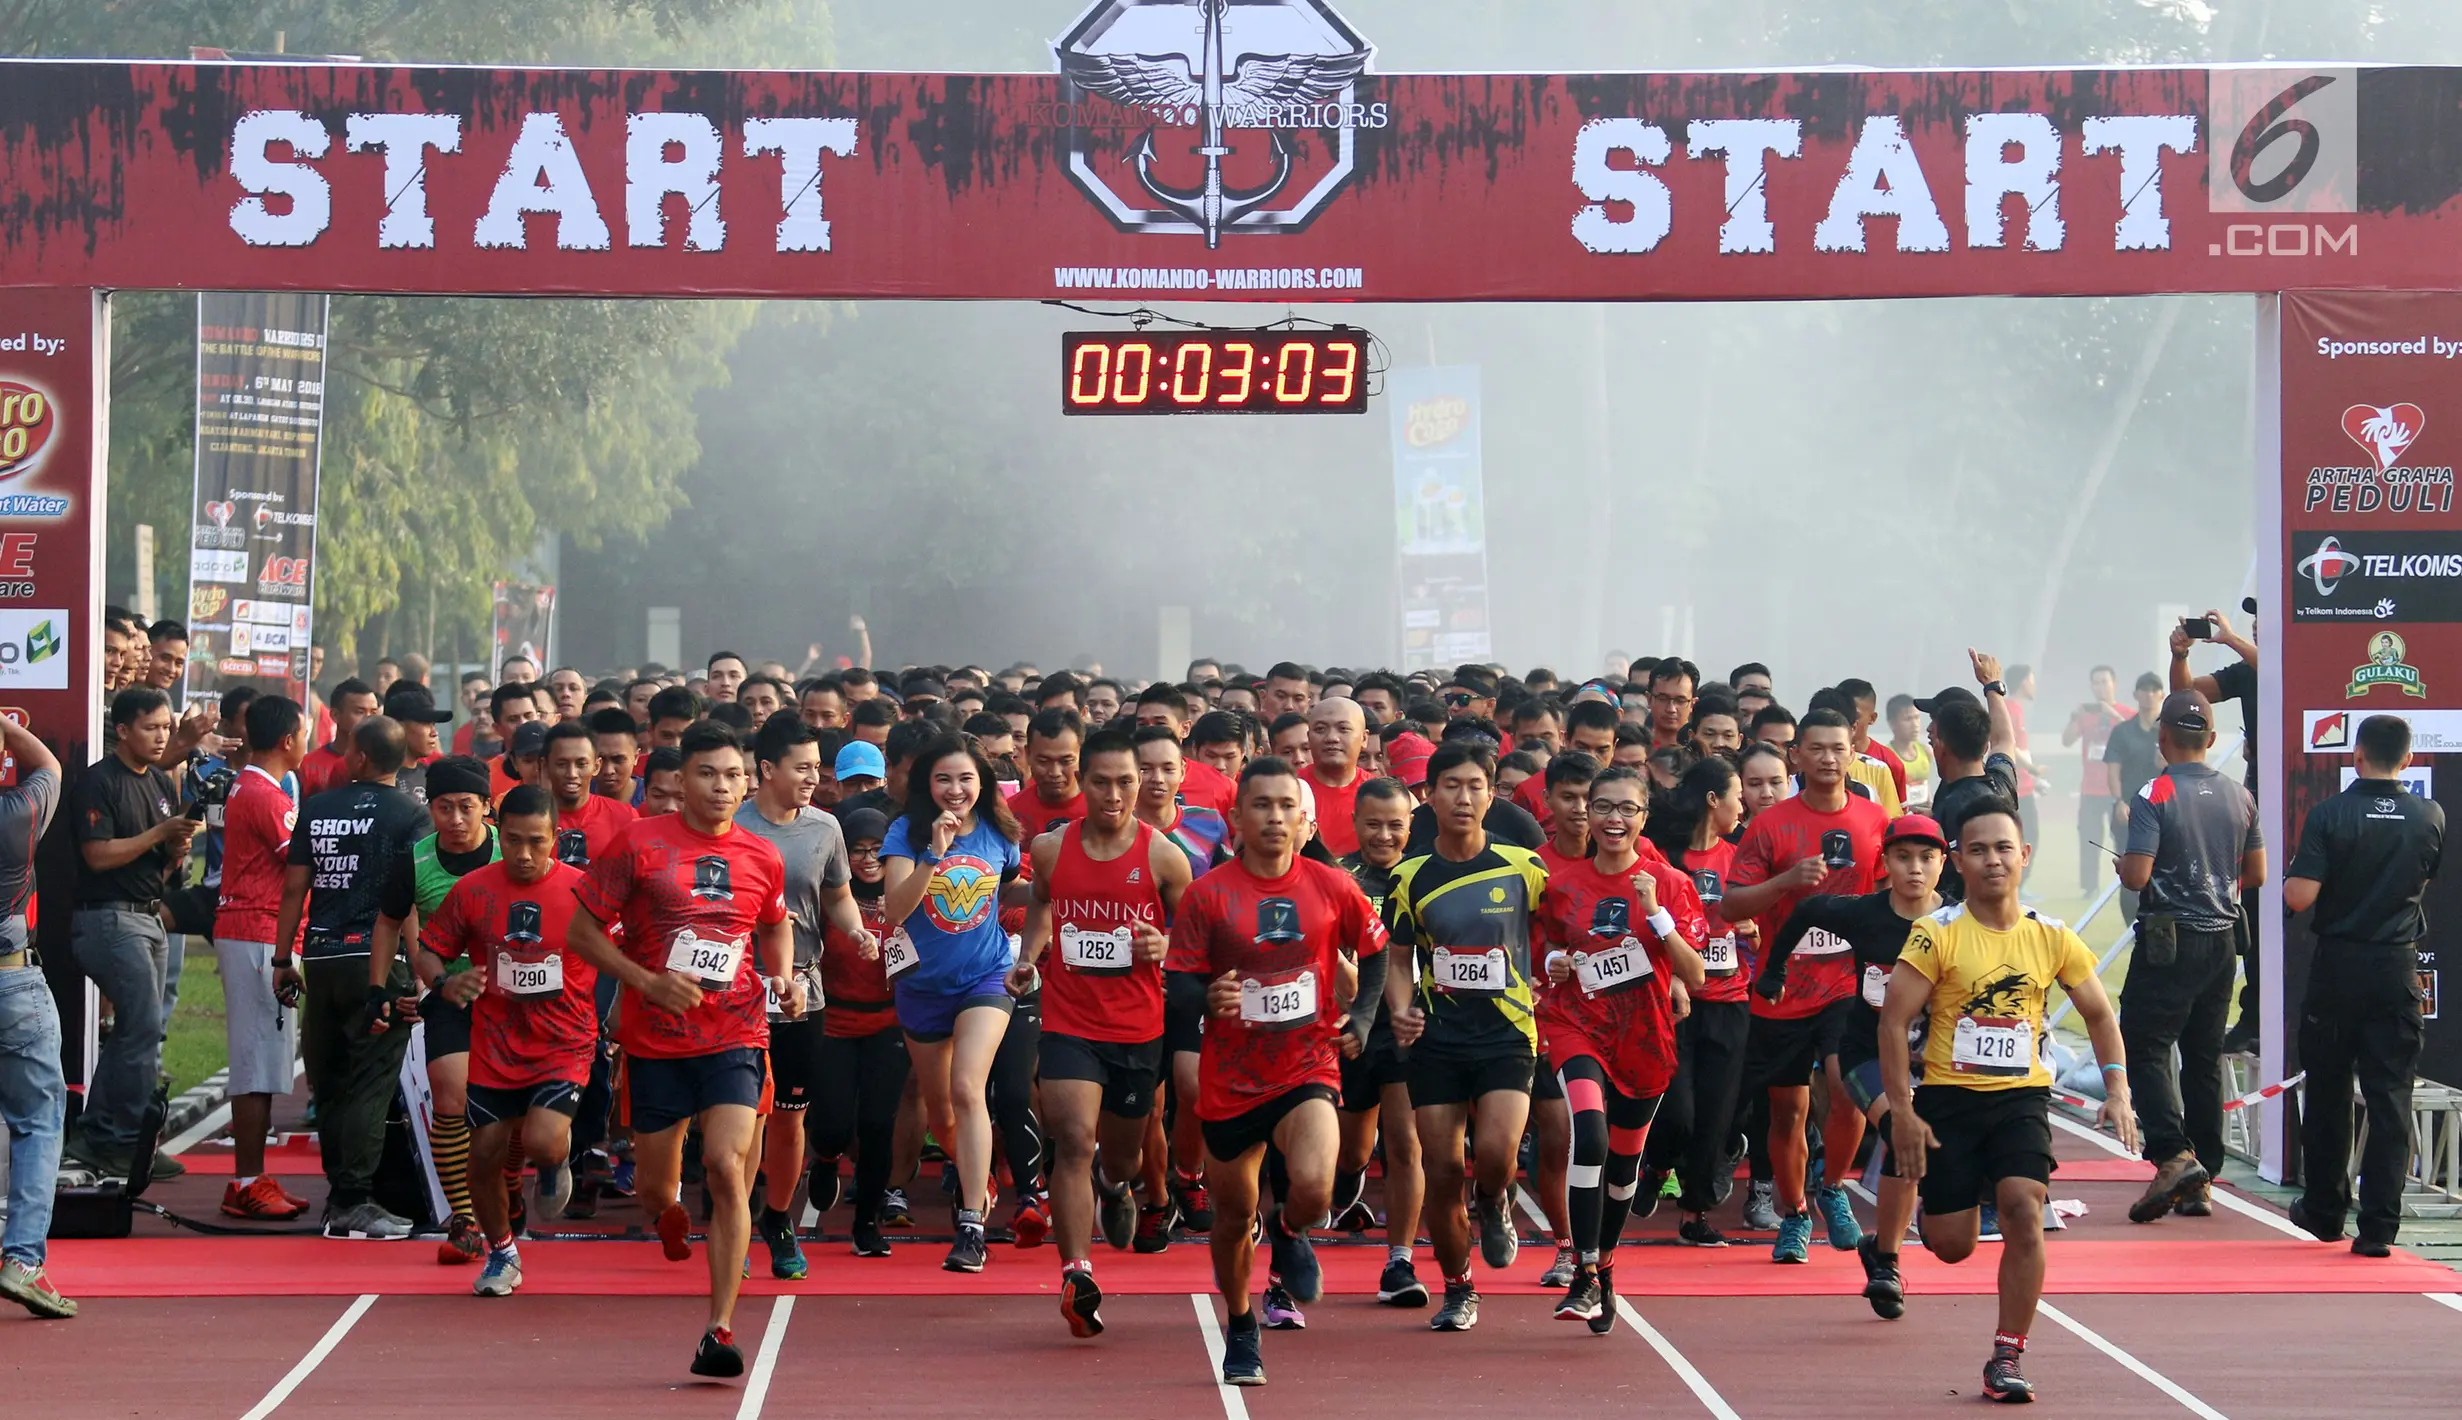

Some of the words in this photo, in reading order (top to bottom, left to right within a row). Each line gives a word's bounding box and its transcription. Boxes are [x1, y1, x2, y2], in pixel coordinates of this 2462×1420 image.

[1027, 103, 1201, 129] KOMANDO
[1209, 102, 1389, 129] WARRIORS
[229, 109, 858, 252] START
[1571, 113, 2198, 253] START
[1055, 267, 1363, 290] WWW.KOMANDO-WARRIORS.COM
[34, 333, 65, 356] by:
[2317, 336, 2426, 359] Sponsored
[1070, 343, 1357, 404] 00:03:03
[2307, 467, 2375, 484] ARTHA
[2383, 467, 2453, 484] GRAHA
[13, 496, 66, 513] Water
[2305, 484, 2453, 513] PEDULI
[258, 552, 309, 585] ACE
[2305, 607, 2333, 616] Telkom
[2335, 607, 2373, 616] Indonesia
[2355, 666, 2417, 682] GULAKU
[309, 818, 374, 836] SHOW
[310, 838, 340, 854] ME
[313, 855, 359, 872] YOUR
[313, 873, 353, 889] BEST
[1480, 906, 1515, 914] TANGERANG
[690, 948, 729, 973] 1342
[885, 944, 905, 969] 296
[1078, 940, 1115, 960] 1252
[1702, 946, 1728, 963] 458
[512, 969, 547, 987] 1290
[1450, 963, 1488, 982] 1264
[1593, 954, 1630, 981] 1457
[1262, 991, 1300, 1015] 1343
[1976, 1036, 2016, 1058] 1218
